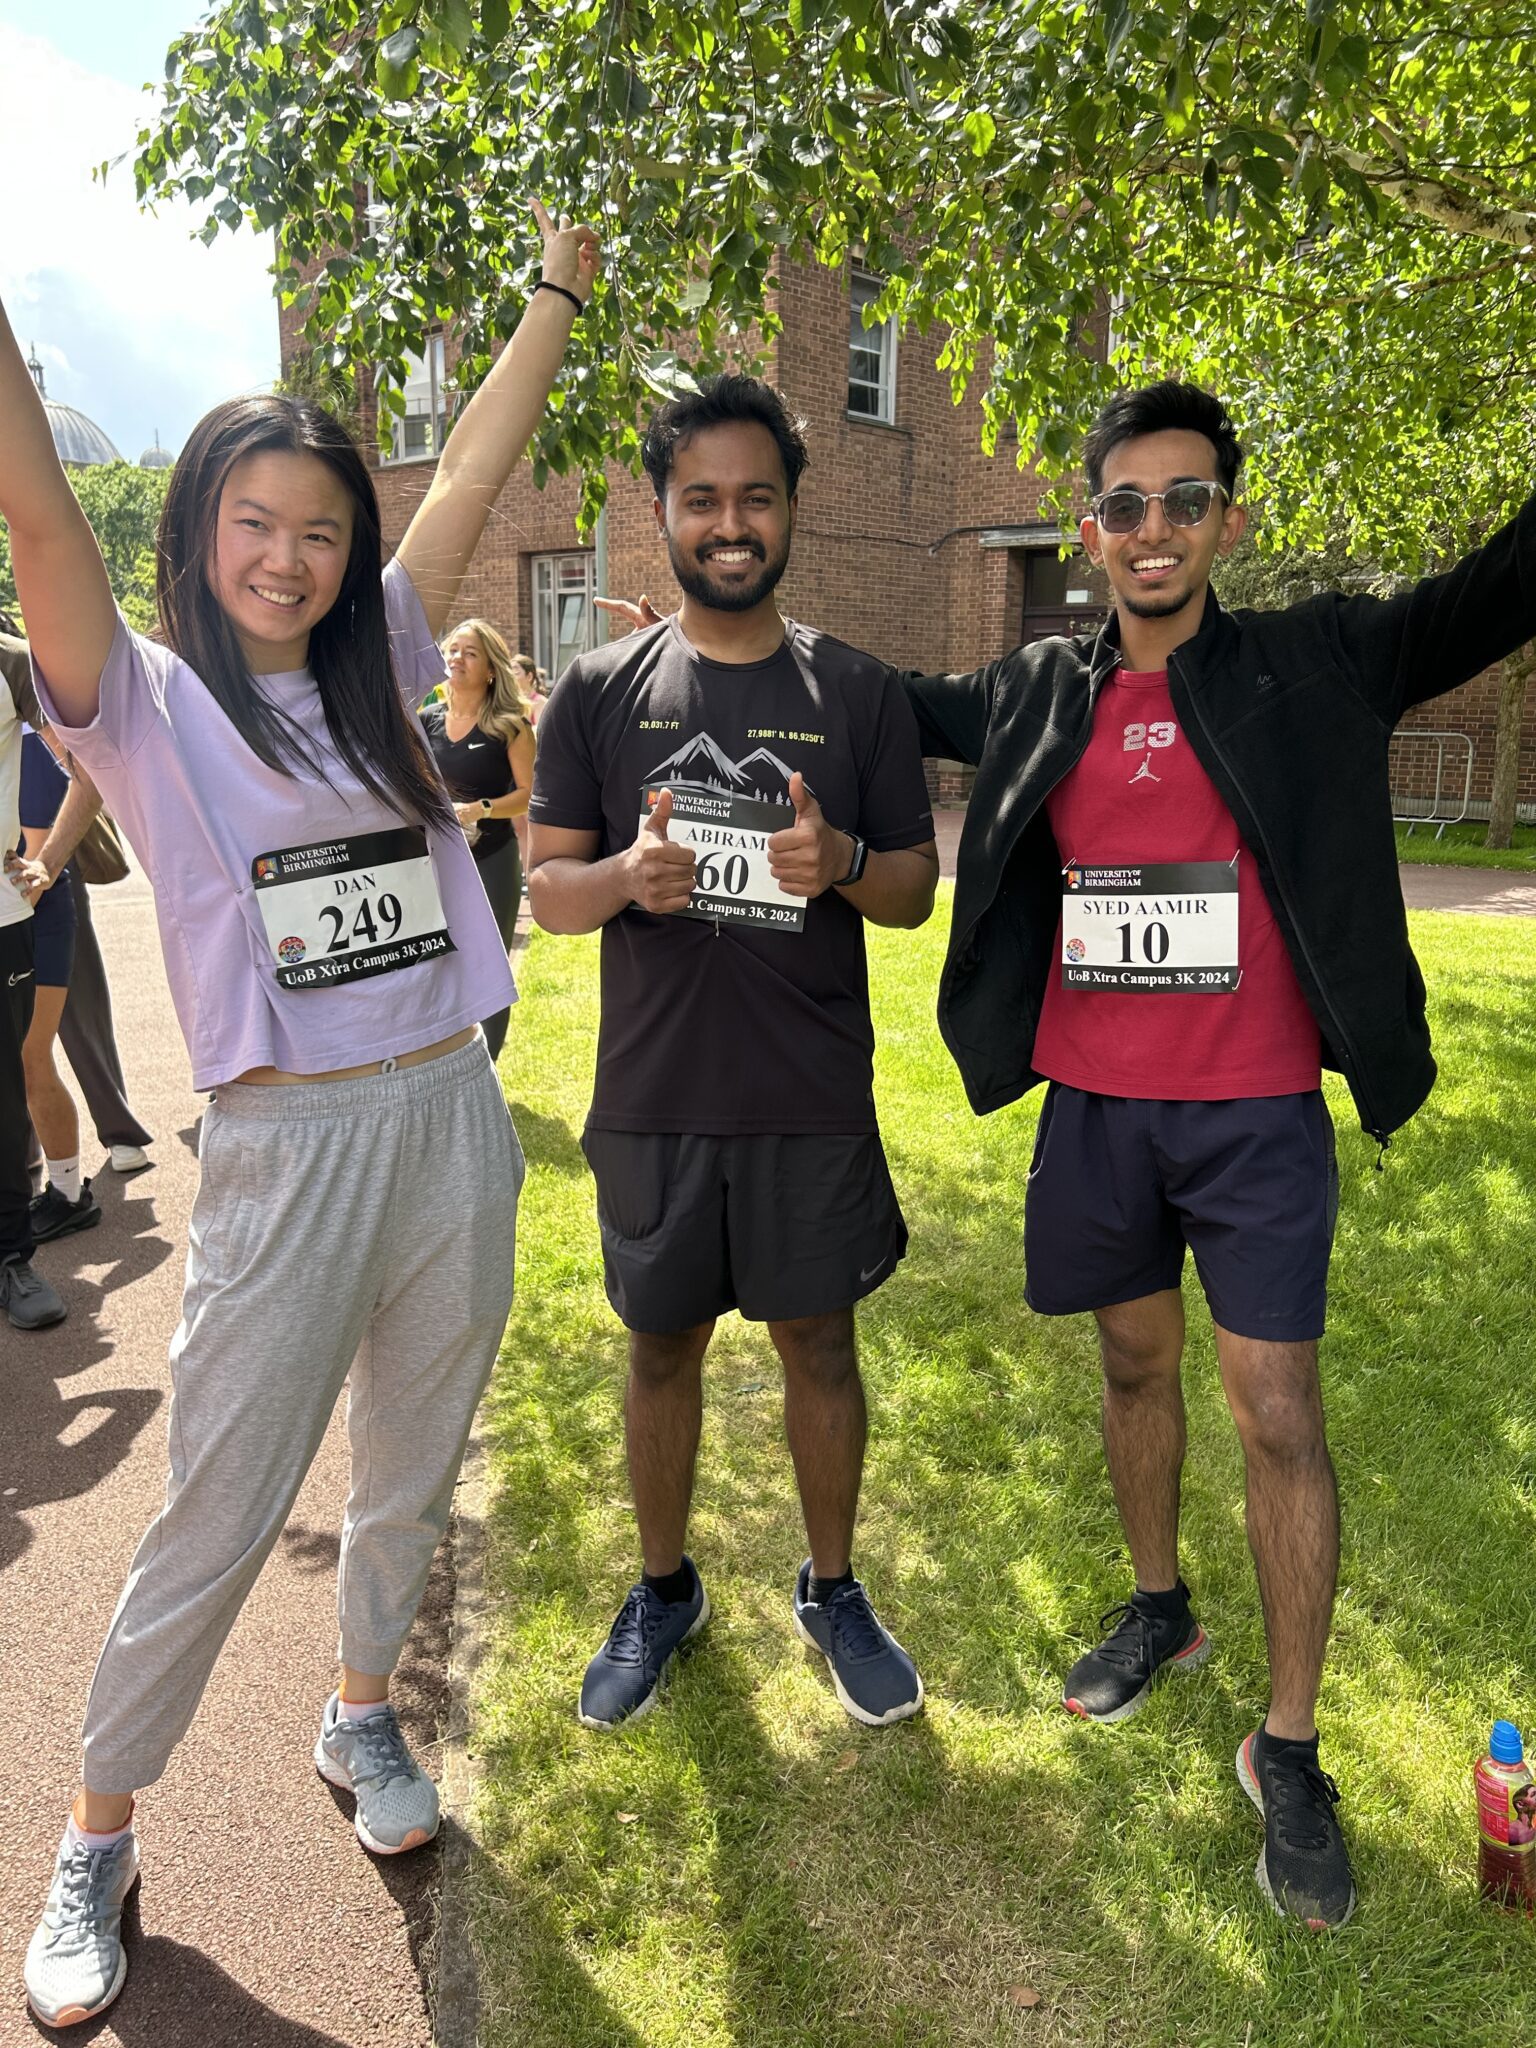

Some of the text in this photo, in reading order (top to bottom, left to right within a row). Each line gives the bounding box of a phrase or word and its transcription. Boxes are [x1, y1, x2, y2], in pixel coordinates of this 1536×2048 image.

[639, 720, 680, 730] 29,031.7 FT
[1123, 721, 1177, 752] 23
[671, 793, 723, 809] UNIVERSITY
[685, 827, 767, 851] ABIRAM
[281, 845, 339, 864] UNIVERSITY
[282, 852, 350, 874] BIRMINGHAM
[333, 872, 377, 896] DAN
[696, 851, 749, 895] 60
[1084, 869, 1133, 879] UNIVERSITY
[1084, 878, 1142, 887] BIRMINGHAM
[696, 899, 746, 917] Campus
[747, 905, 768, 919] 3K
[768, 908, 798, 923] 2024
[1083, 899, 1209, 915] SYED AAMIR
[317, 892, 403, 954] 249
[1115, 921, 1170, 964] 10
[284, 936, 447, 986] UoB Xtra Campus 3K 2024
[1067, 969, 1230, 988] UoB Xtra Campus 3K 2024
